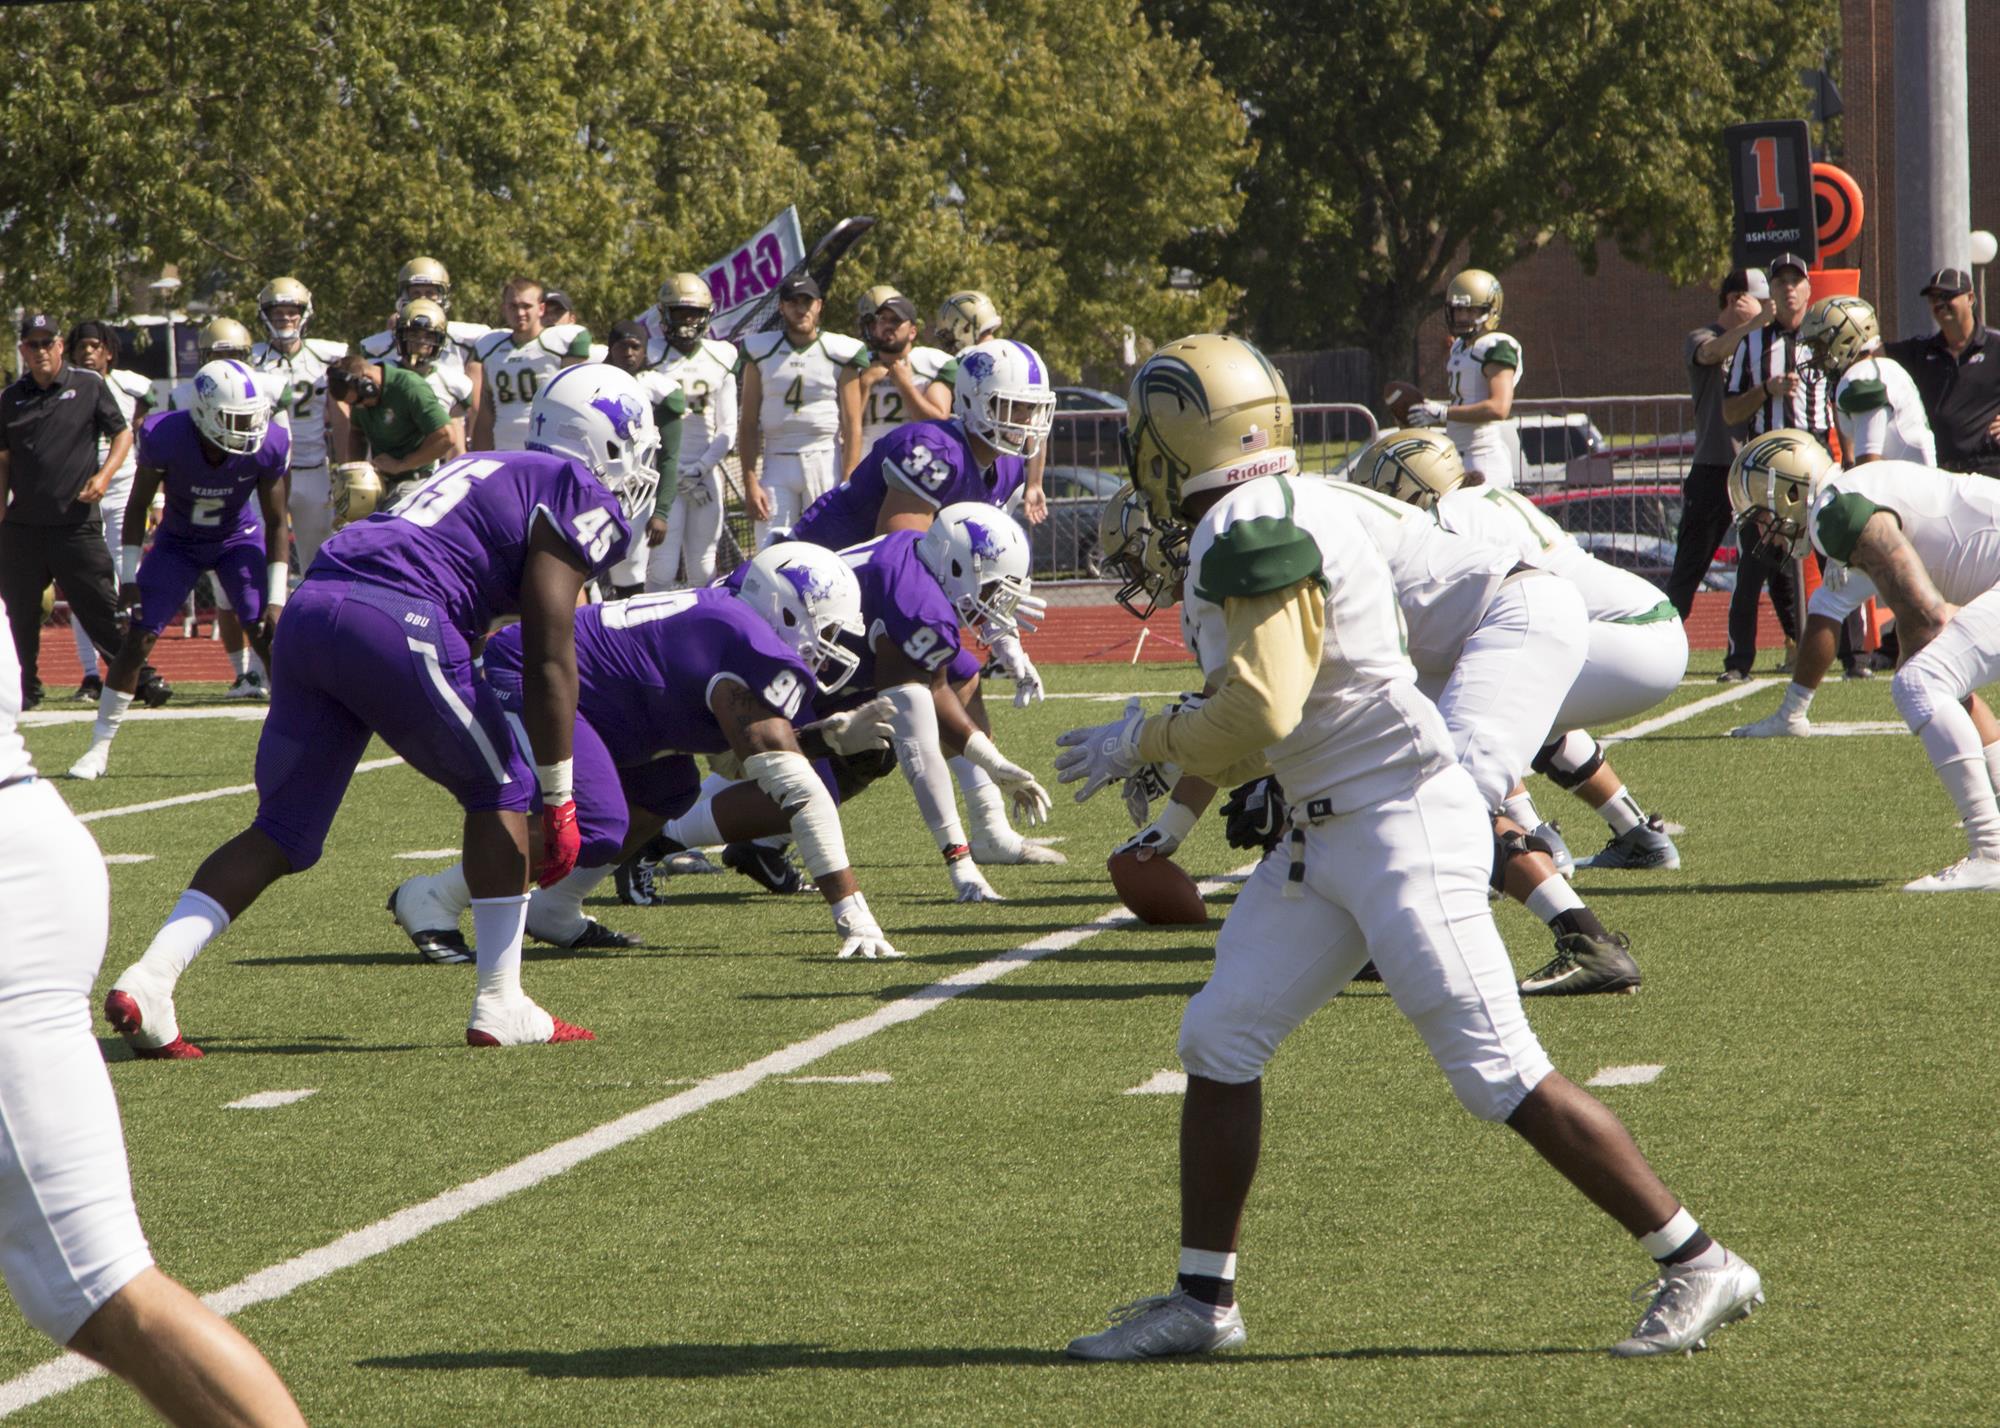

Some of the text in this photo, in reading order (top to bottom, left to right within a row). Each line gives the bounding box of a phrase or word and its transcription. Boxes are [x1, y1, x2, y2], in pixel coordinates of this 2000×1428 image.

[1749, 137, 1784, 212] 1
[496, 368, 538, 403] 80
[784, 374, 803, 413] 4
[869, 392, 903, 424] 12
[902, 445, 950, 491] 33
[192, 498, 225, 526] 2
[572, 506, 623, 563] 45
[903, 626, 955, 672] 94
